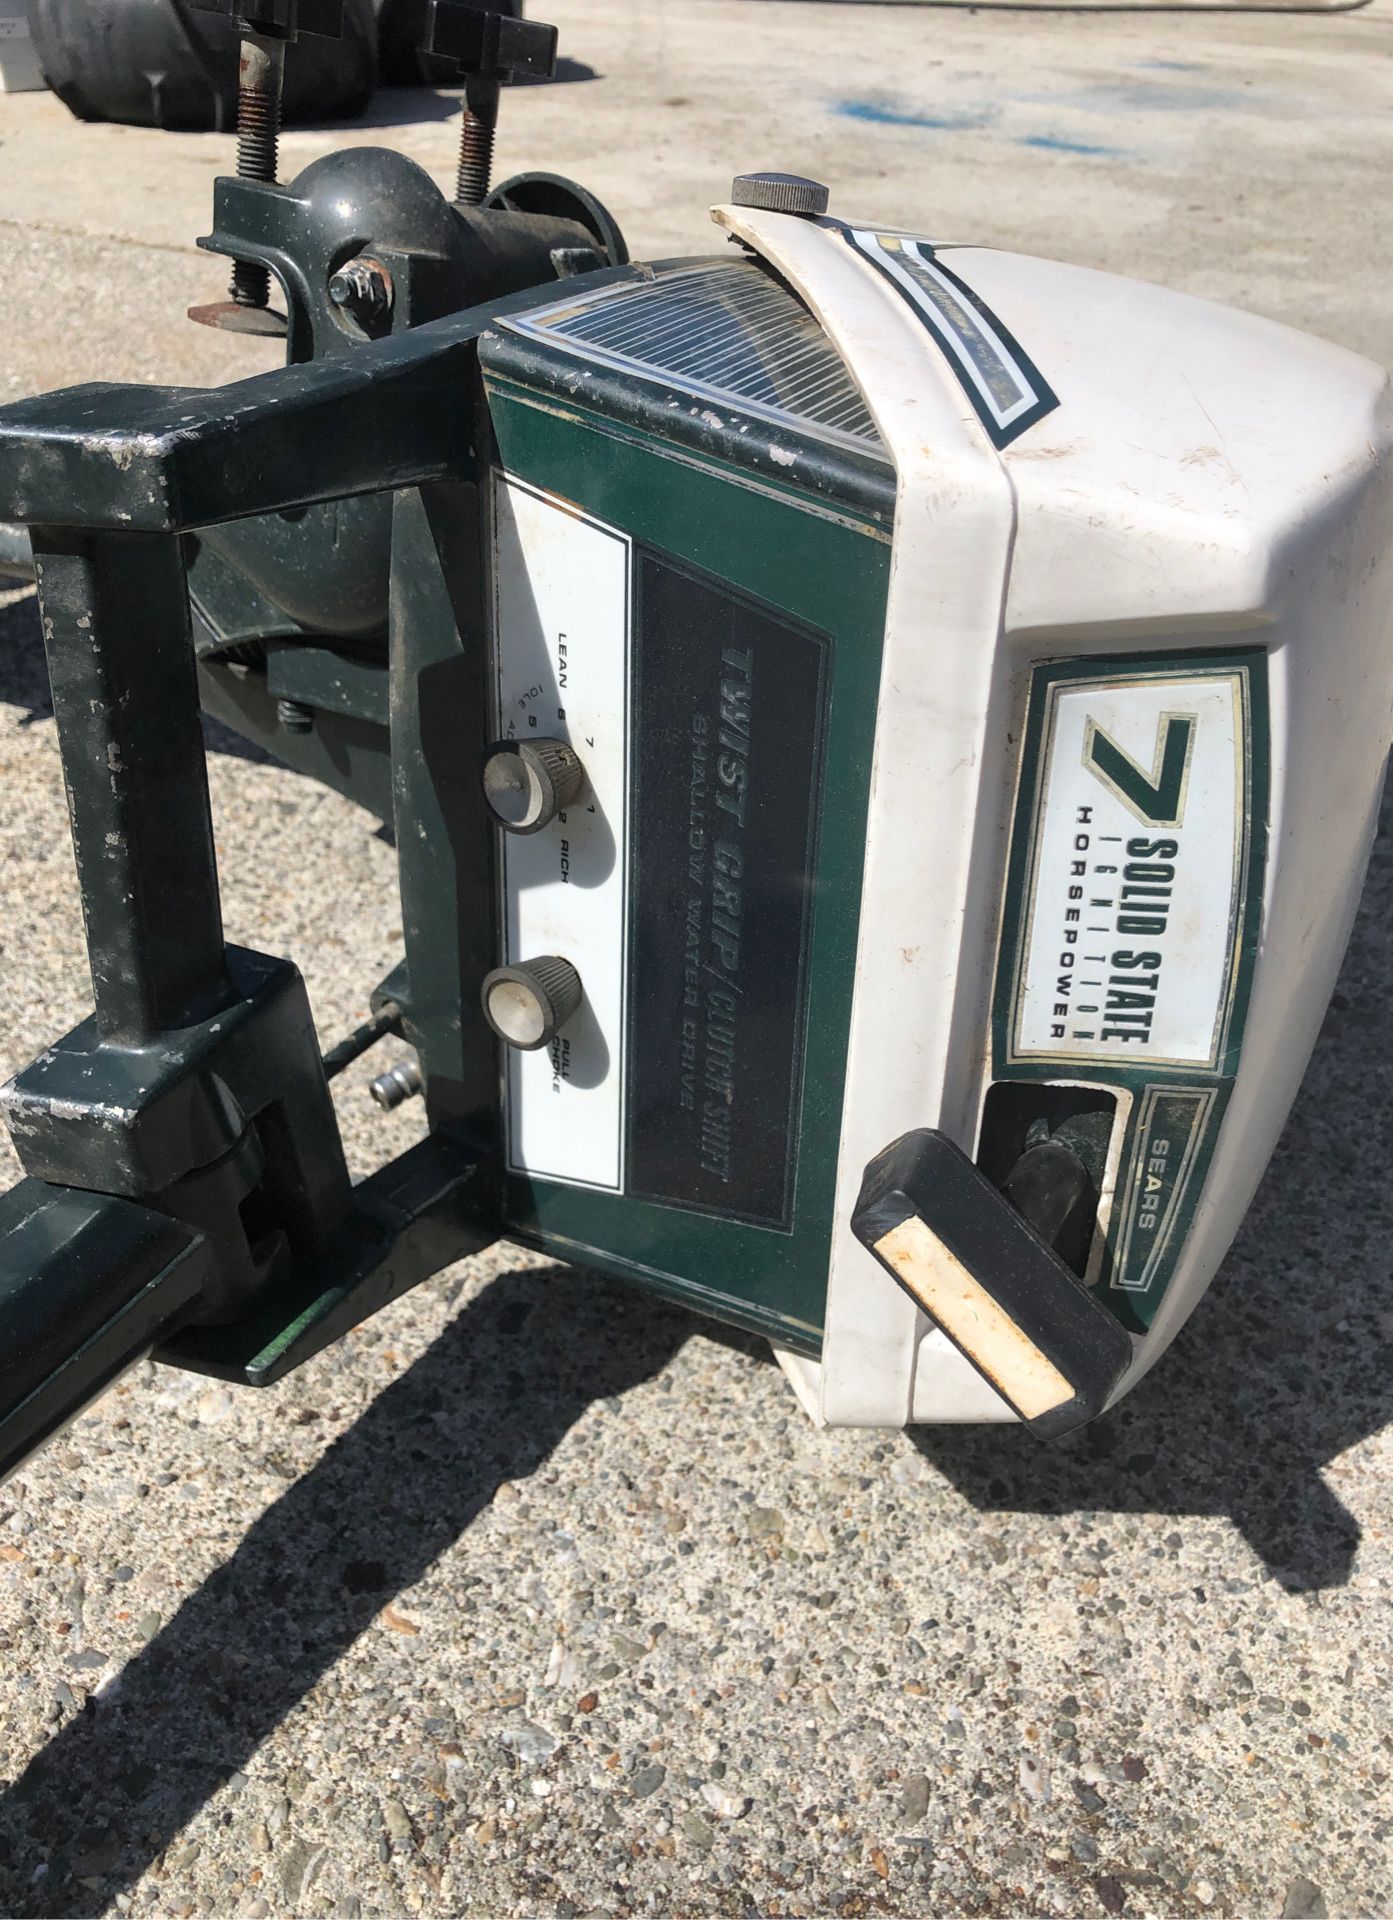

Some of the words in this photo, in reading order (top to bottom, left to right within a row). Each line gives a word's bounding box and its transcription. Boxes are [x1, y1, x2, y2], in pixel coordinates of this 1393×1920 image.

[518, 684, 544, 710] IDLE
[557, 632, 568, 689] LEAN
[528, 715, 538, 728] 5
[557, 707, 566, 721] 6
[585, 736, 595, 748] 7
[716, 648, 753, 828] TWIST
[586, 804, 596, 814] 1
[689, 714, 707, 885] SHALLOW
[1081, 711, 1198, 829] 7
[557, 811, 567, 824] 2
[560, 838, 569, 884] RICH
[1116, 837, 1179, 935] SOLID
[684, 897, 704, 1007] WATER
[1050, 805, 1093, 1039] HORSEPOWER
[1072, 835, 1122, 1040] IGNITION
[1100, 950, 1162, 1044] STATE
[552, 1035, 561, 1094] CHOKE
[561, 1038, 570, 1079] PULL
[680, 1018, 698, 1111] DRIVE
[701, 1098, 732, 1183] SHIFT
[1138, 1138, 1170, 1230] SEARS
